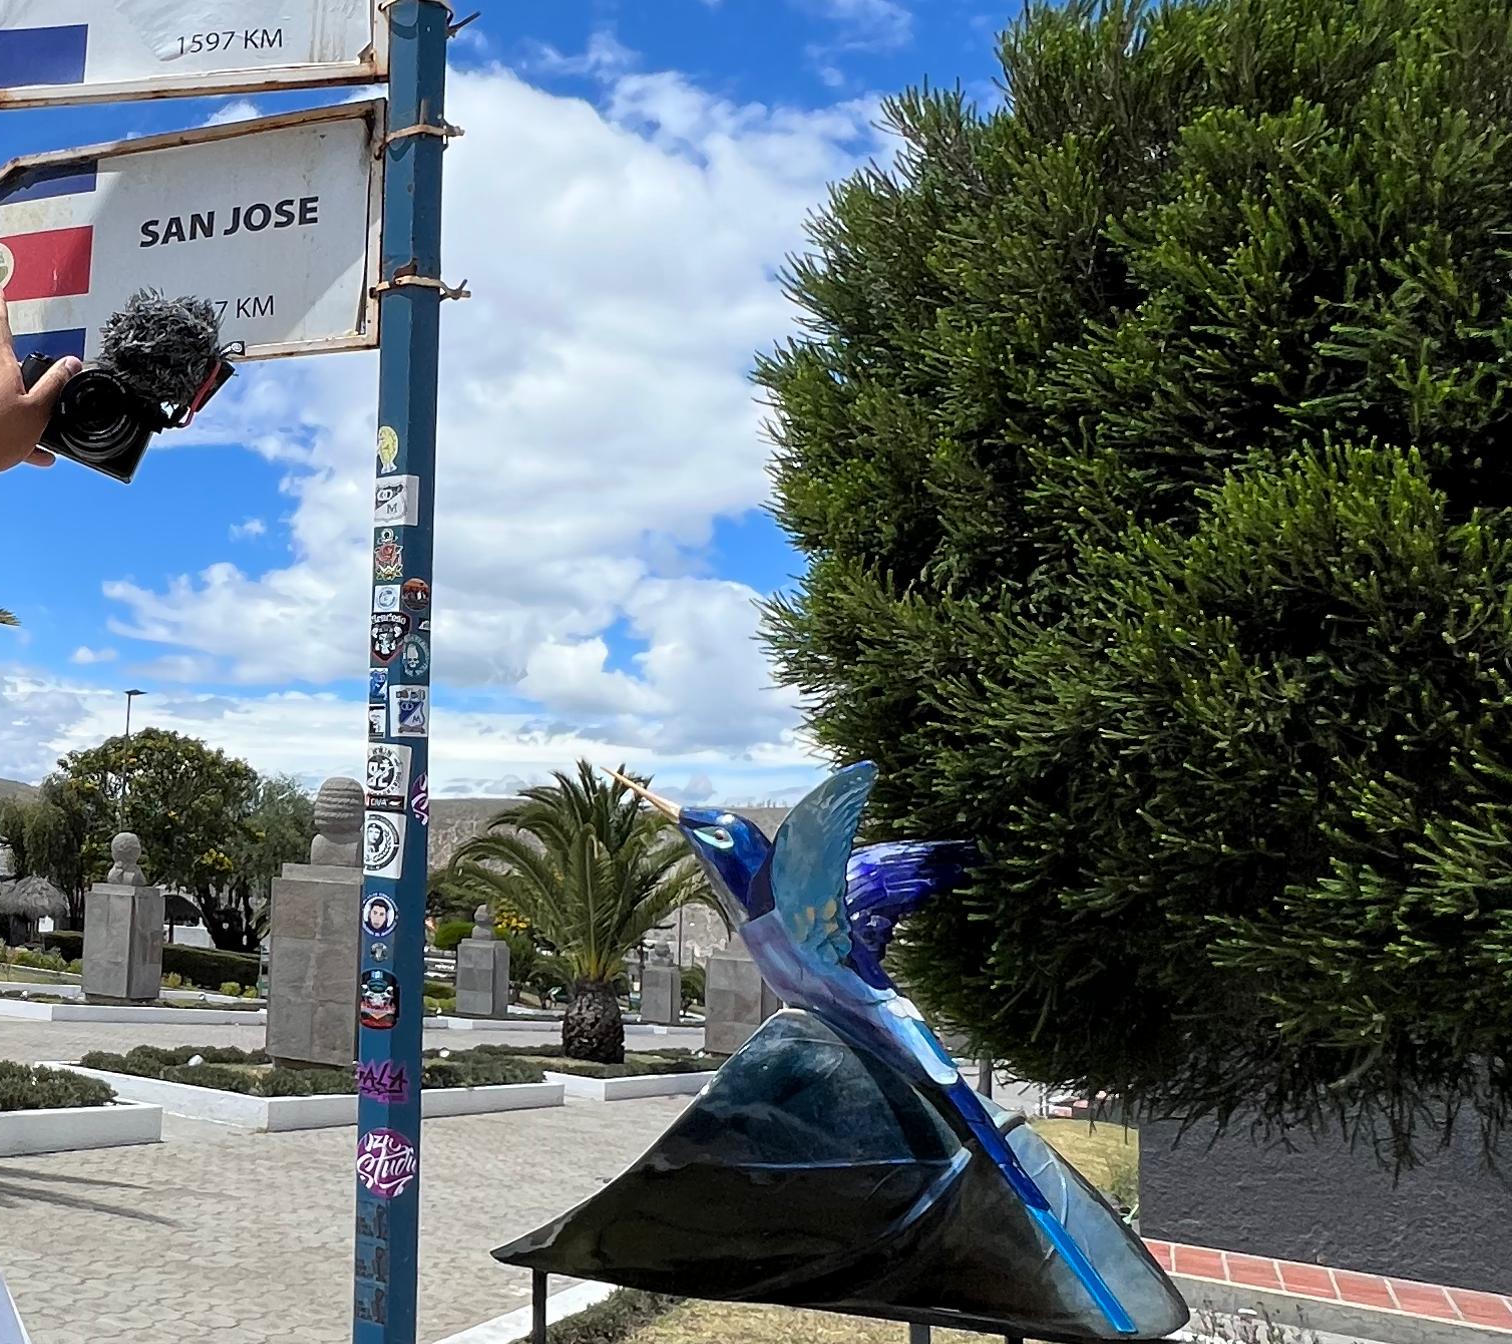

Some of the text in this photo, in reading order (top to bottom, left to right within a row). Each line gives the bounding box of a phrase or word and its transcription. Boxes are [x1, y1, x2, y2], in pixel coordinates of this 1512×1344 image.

[177, 28, 284, 55] 1597 KM
[140, 196, 319, 248] SAN JOSE
[235, 294, 275, 319] KM
